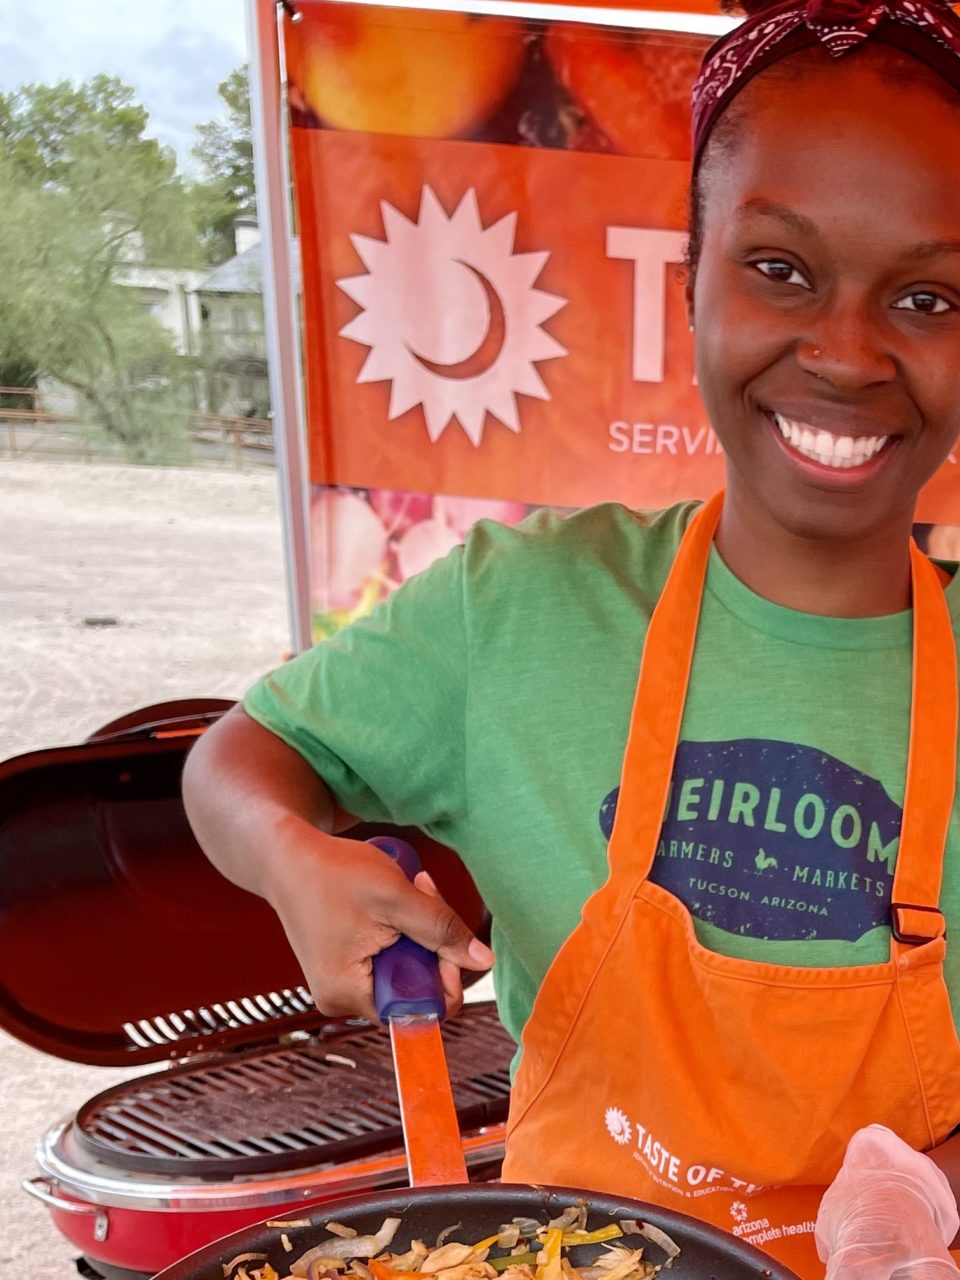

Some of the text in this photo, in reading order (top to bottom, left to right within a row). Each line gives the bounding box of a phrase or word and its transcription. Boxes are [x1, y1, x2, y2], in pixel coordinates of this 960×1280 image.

[607, 420, 724, 456] SERVI
[664, 776, 900, 876] EIRLOOM
[656, 839, 885, 897] ARMERS MARKETS
[760, 895, 829, 917] ARIZONA
[636, 1122, 681, 1184] TASTE
[686, 1164, 725, 1187] OF
[732, 1217, 770, 1237] arizona
[742, 1227, 783, 1246] omplete
